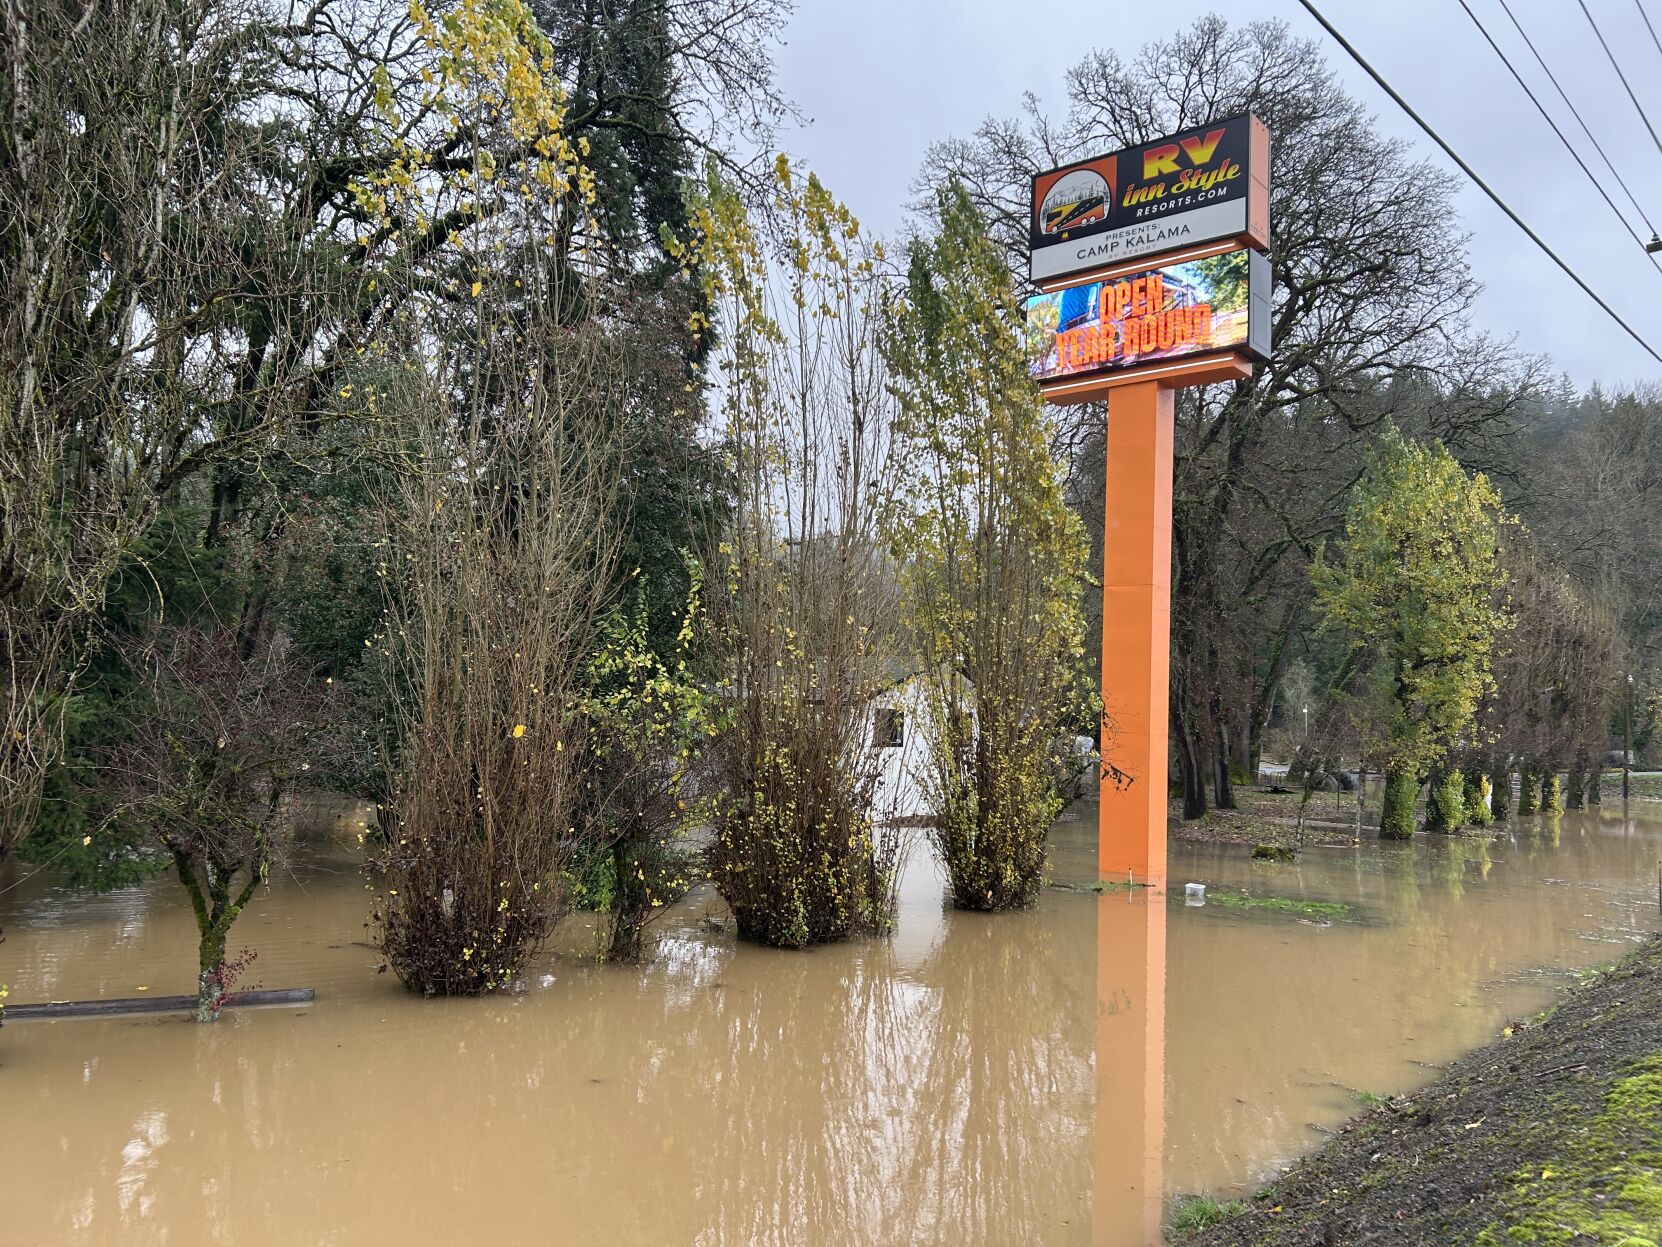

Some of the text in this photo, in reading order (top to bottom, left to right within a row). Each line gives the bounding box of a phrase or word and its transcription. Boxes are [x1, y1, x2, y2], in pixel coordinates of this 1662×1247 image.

[1143, 128, 1226, 180] RV
[1123, 158, 1241, 208] inn Style
[1136, 187, 1228, 218] RESORTS.COM
[1076, 224, 1191, 260] CAMP KALAMA
[1105, 223, 1161, 241] PRESENTS:
[1100, 274, 1164, 325] OPEN
[1055, 304, 1212, 368] YEAR ROUND
